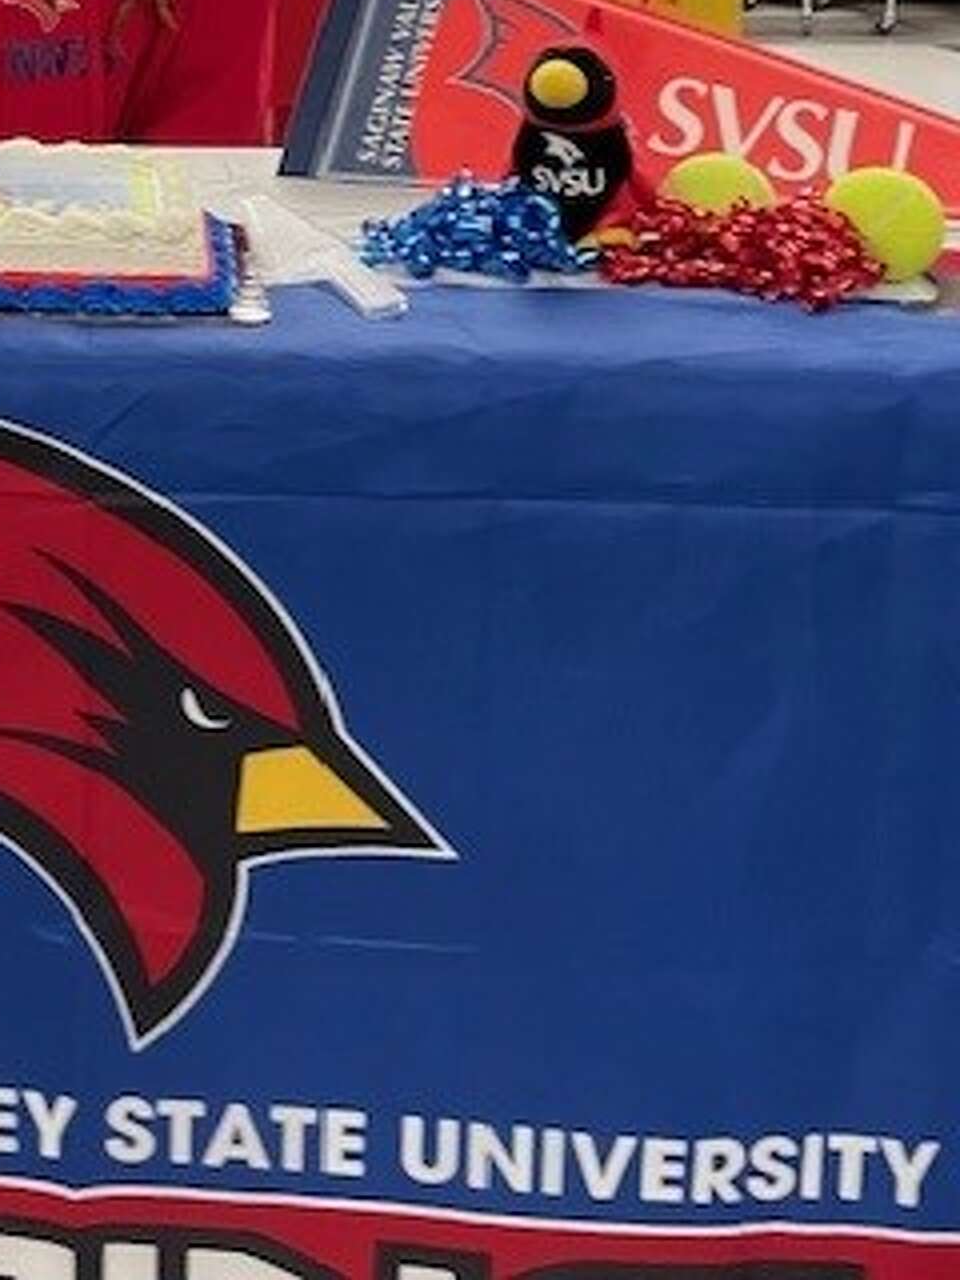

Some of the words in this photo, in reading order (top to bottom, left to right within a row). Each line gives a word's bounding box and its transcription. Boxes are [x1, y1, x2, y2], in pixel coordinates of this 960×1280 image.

[356, 47, 405, 163] SAGINAW
[381, 102, 414, 169] STATE
[648, 77, 917, 183] SVSU
[531, 167, 606, 196] SVSU
[105, 1096, 368, 1177] STATE
[400, 1115, 941, 1208] UNIVERSITY
